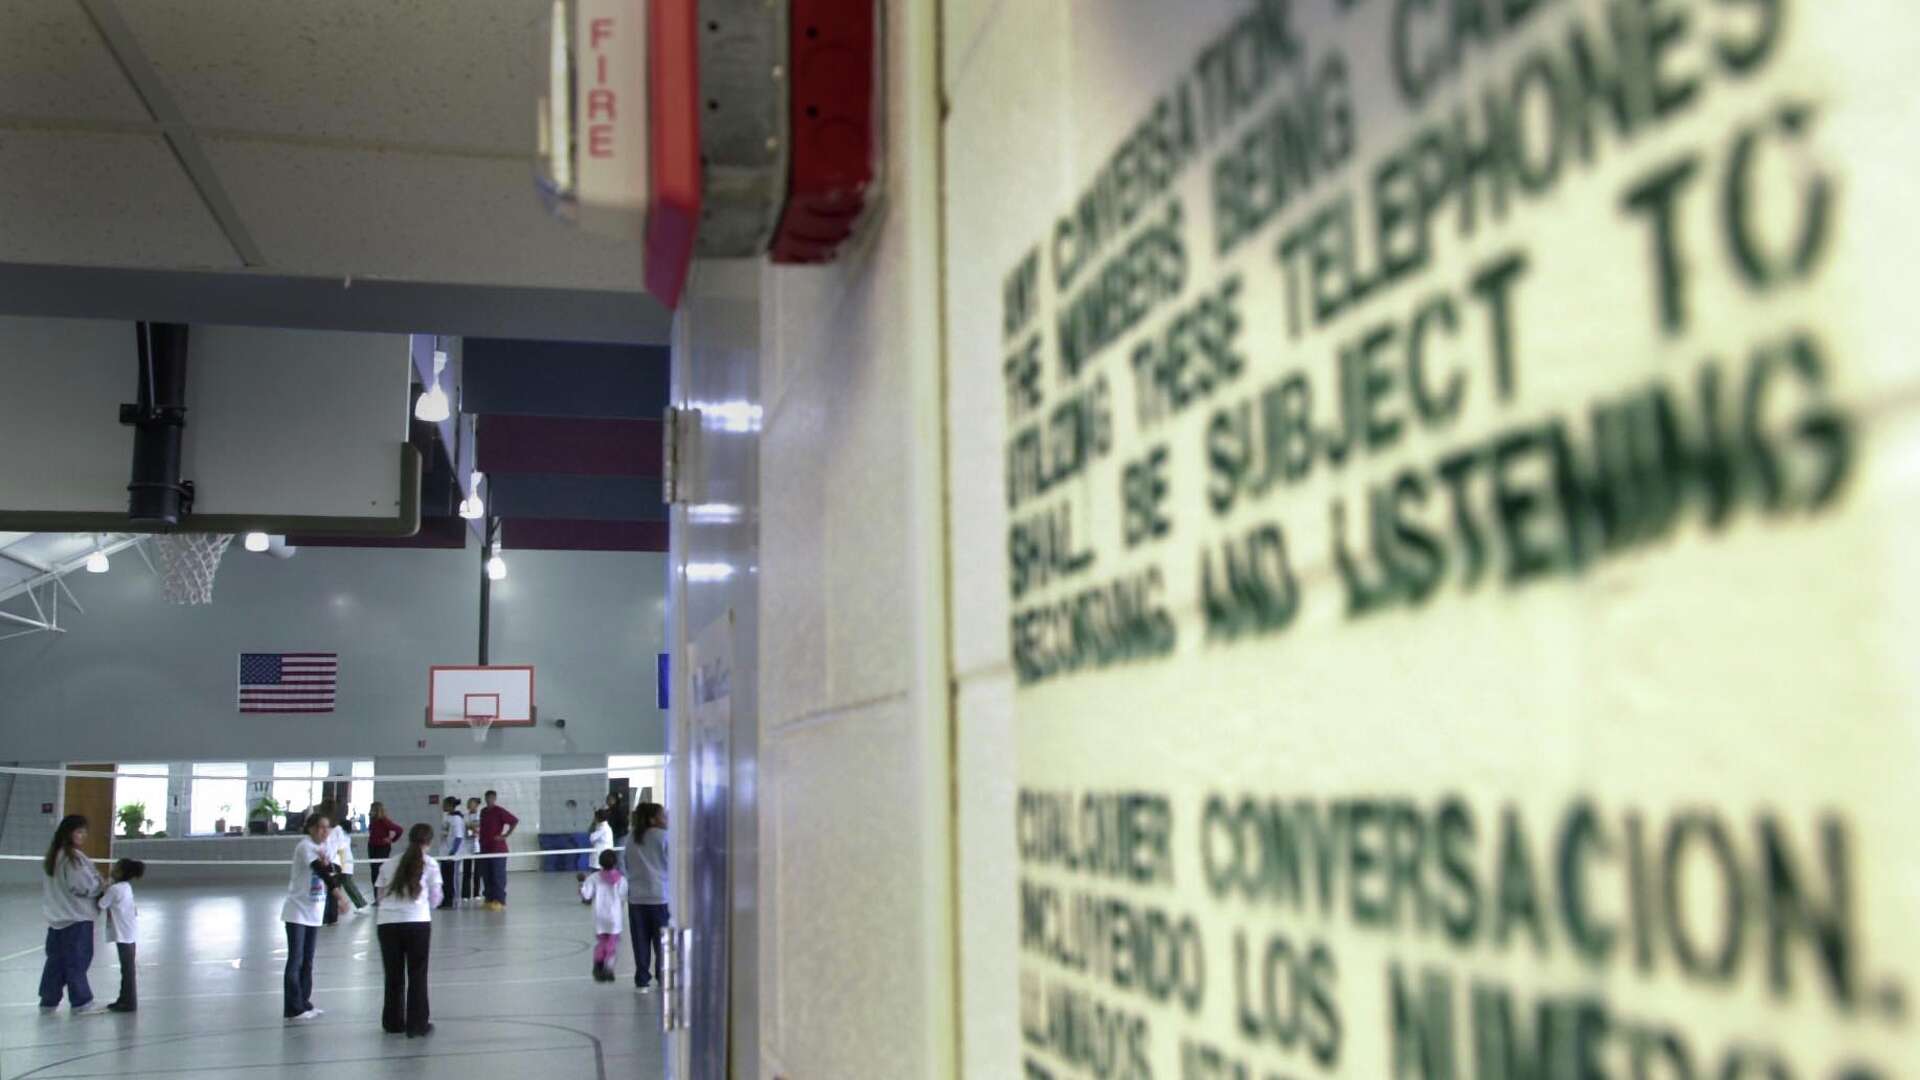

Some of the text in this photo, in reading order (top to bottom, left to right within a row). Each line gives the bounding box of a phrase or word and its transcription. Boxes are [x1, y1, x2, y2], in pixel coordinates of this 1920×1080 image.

[588, 18, 616, 158] FIRE
[1004, 331, 1041, 428] THE
[1056, 198, 1188, 385] NUMBERS
[1212, 50, 1354, 260] BEING
[1009, 500, 1096, 600] SHALL
[1122, 445, 1170, 549] BE
[1205, 250, 1528, 518] SUBJECT
[1130, 272, 1244, 433] THESE
[1198, 520, 1302, 645] AND
[1332, 332, 1856, 622] LISTENING
[1017, 788, 1176, 888] CUALQUIER
[1232, 925, 1343, 1074] LOS
